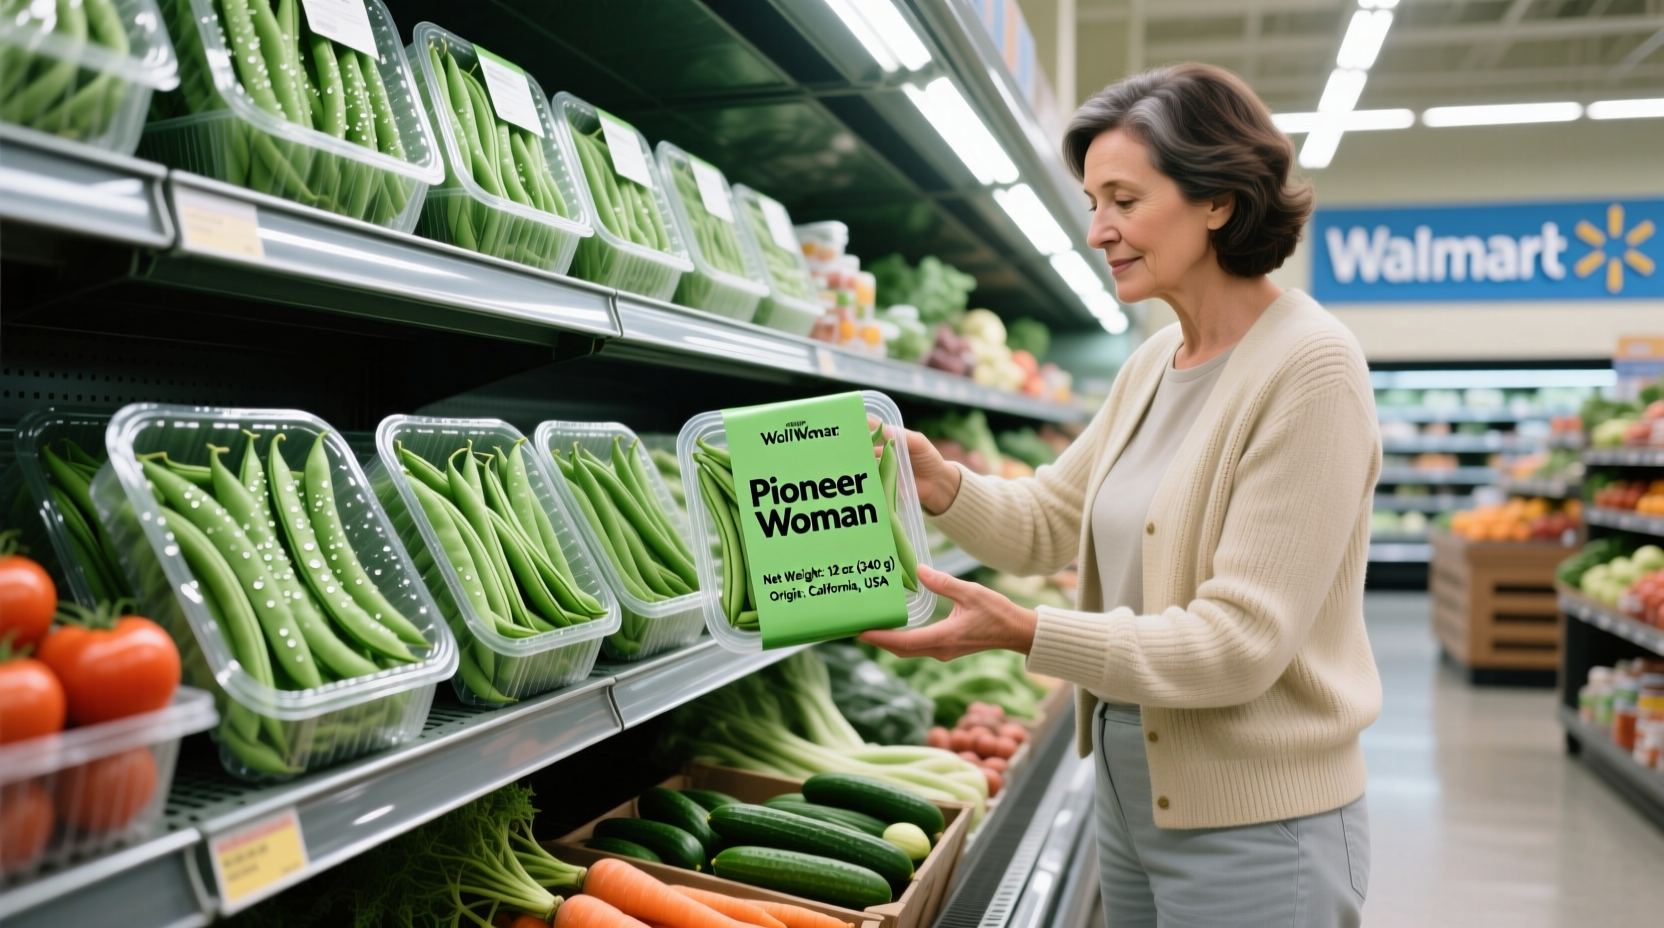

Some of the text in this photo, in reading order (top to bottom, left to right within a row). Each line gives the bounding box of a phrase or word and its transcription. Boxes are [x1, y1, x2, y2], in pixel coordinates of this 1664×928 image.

[1325, 221, 1568, 284] Walmart
[749, 472, 868, 508] Pioneer
[755, 502, 878, 538] Woman
[763, 573, 782, 585] Net
[827, 564, 840, 577] 12
[883, 555, 895, 573] g)
[864, 575, 889, 589] USA
